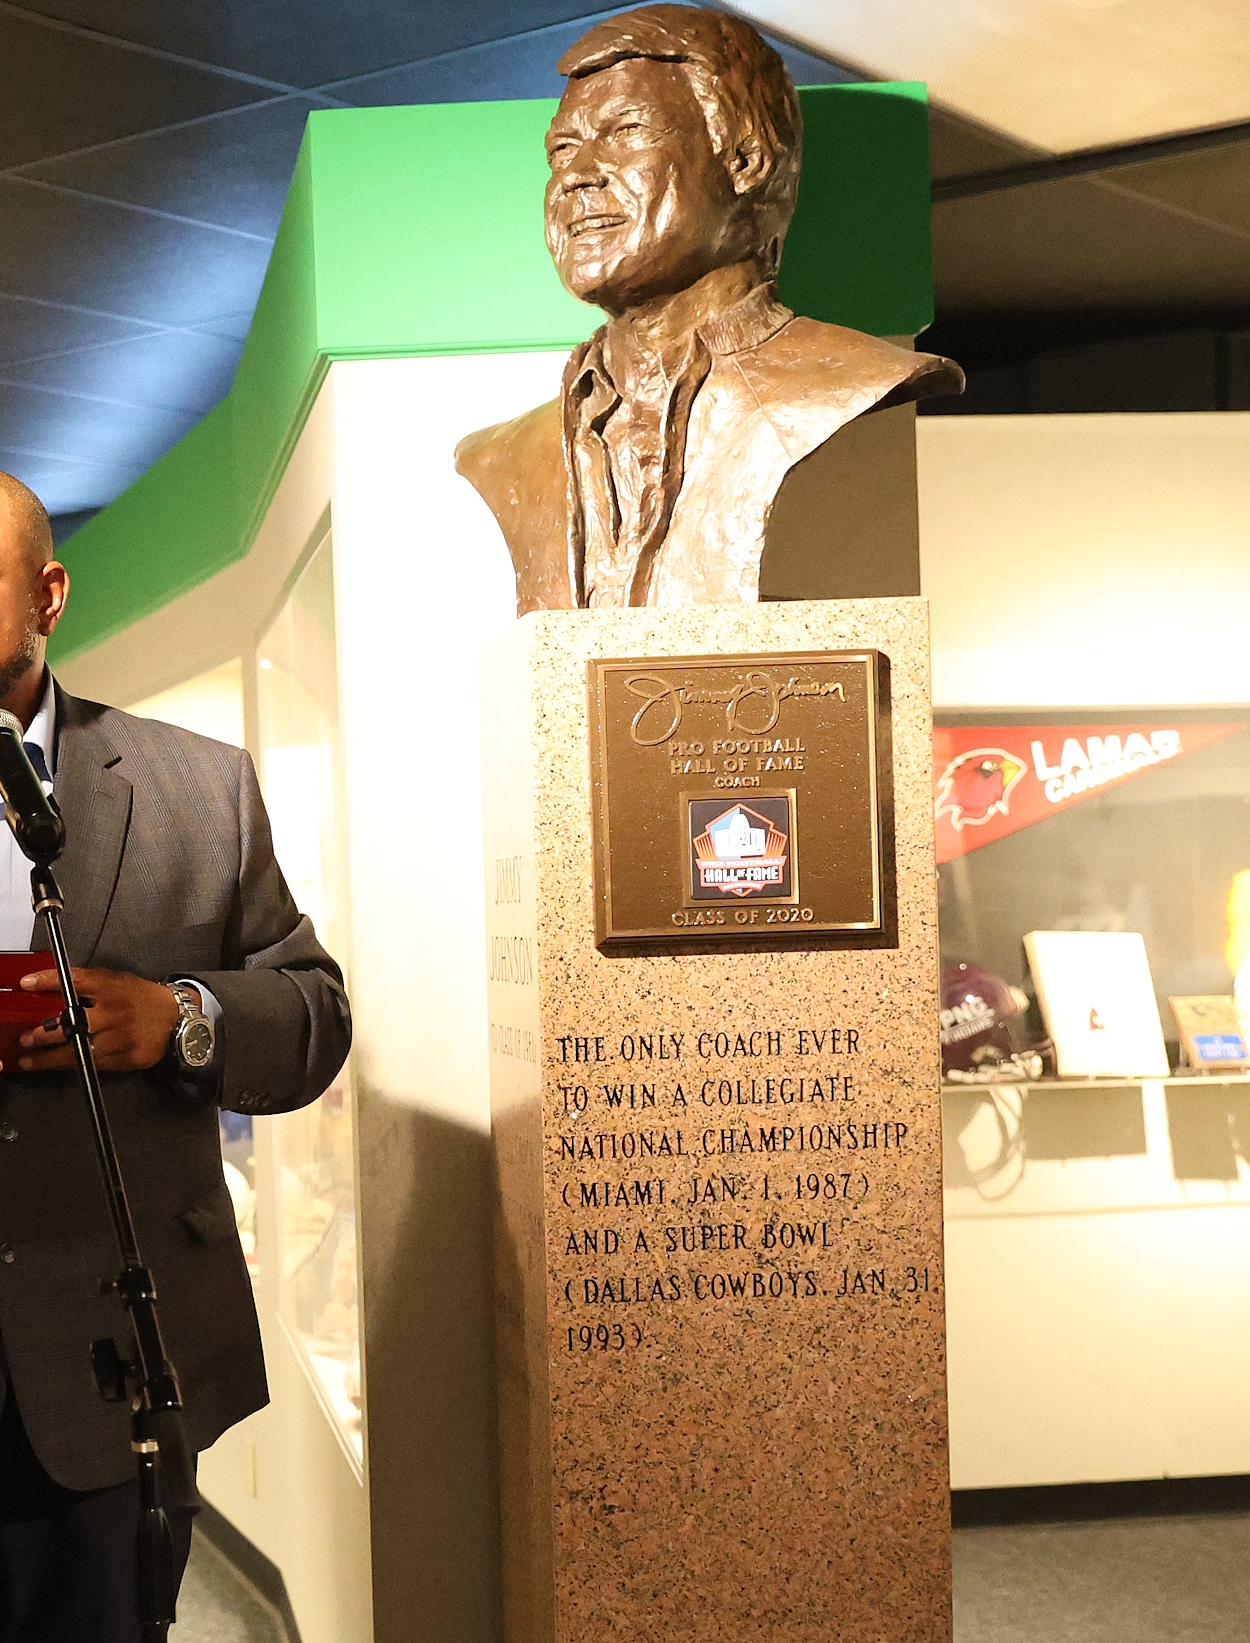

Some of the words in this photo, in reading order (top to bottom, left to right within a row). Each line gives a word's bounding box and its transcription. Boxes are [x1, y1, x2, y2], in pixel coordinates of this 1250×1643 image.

[669, 741, 705, 757] PRO
[712, 738, 806, 756] FOOTBALL
[1031, 729, 1180, 781] LAMAR
[670, 759, 716, 774] HALL
[723, 758, 749, 773] OF
[756, 756, 804, 771] FAME
[713, 776, 761, 788] COACH
[704, 868, 738, 882] HALL
[745, 866, 779, 881] FAME
[671, 909, 727, 927] CLASS
[734, 909, 759, 924] OF
[766, 907, 814, 923] 2020
[490, 936, 533, 985] JOHNSON
[558, 1036, 606, 1062] THE
[621, 1034, 684, 1060] ONLY
[699, 1031, 781, 1058] COACH
[797, 1029, 860, 1055] EVER
[560, 1086, 588, 1111] TO
[605, 1083, 656, 1108] WIN
[672, 1083, 687, 1106] A
[701, 1076, 855, 1106] COLLEGIATE
[560, 1132, 688, 1160] NATIONAL
[702, 1123, 908, 1154] CHAMPIONSHIP
[796, 1172, 869, 1199] 1987)
[565, 1229, 619, 1255] AND
[634, 1229, 649, 1253] A
[665, 1224, 750, 1251] SUPER
[763, 1222, 834, 1248] BOWL
[565, 1275, 681, 1303] (DALLAS
